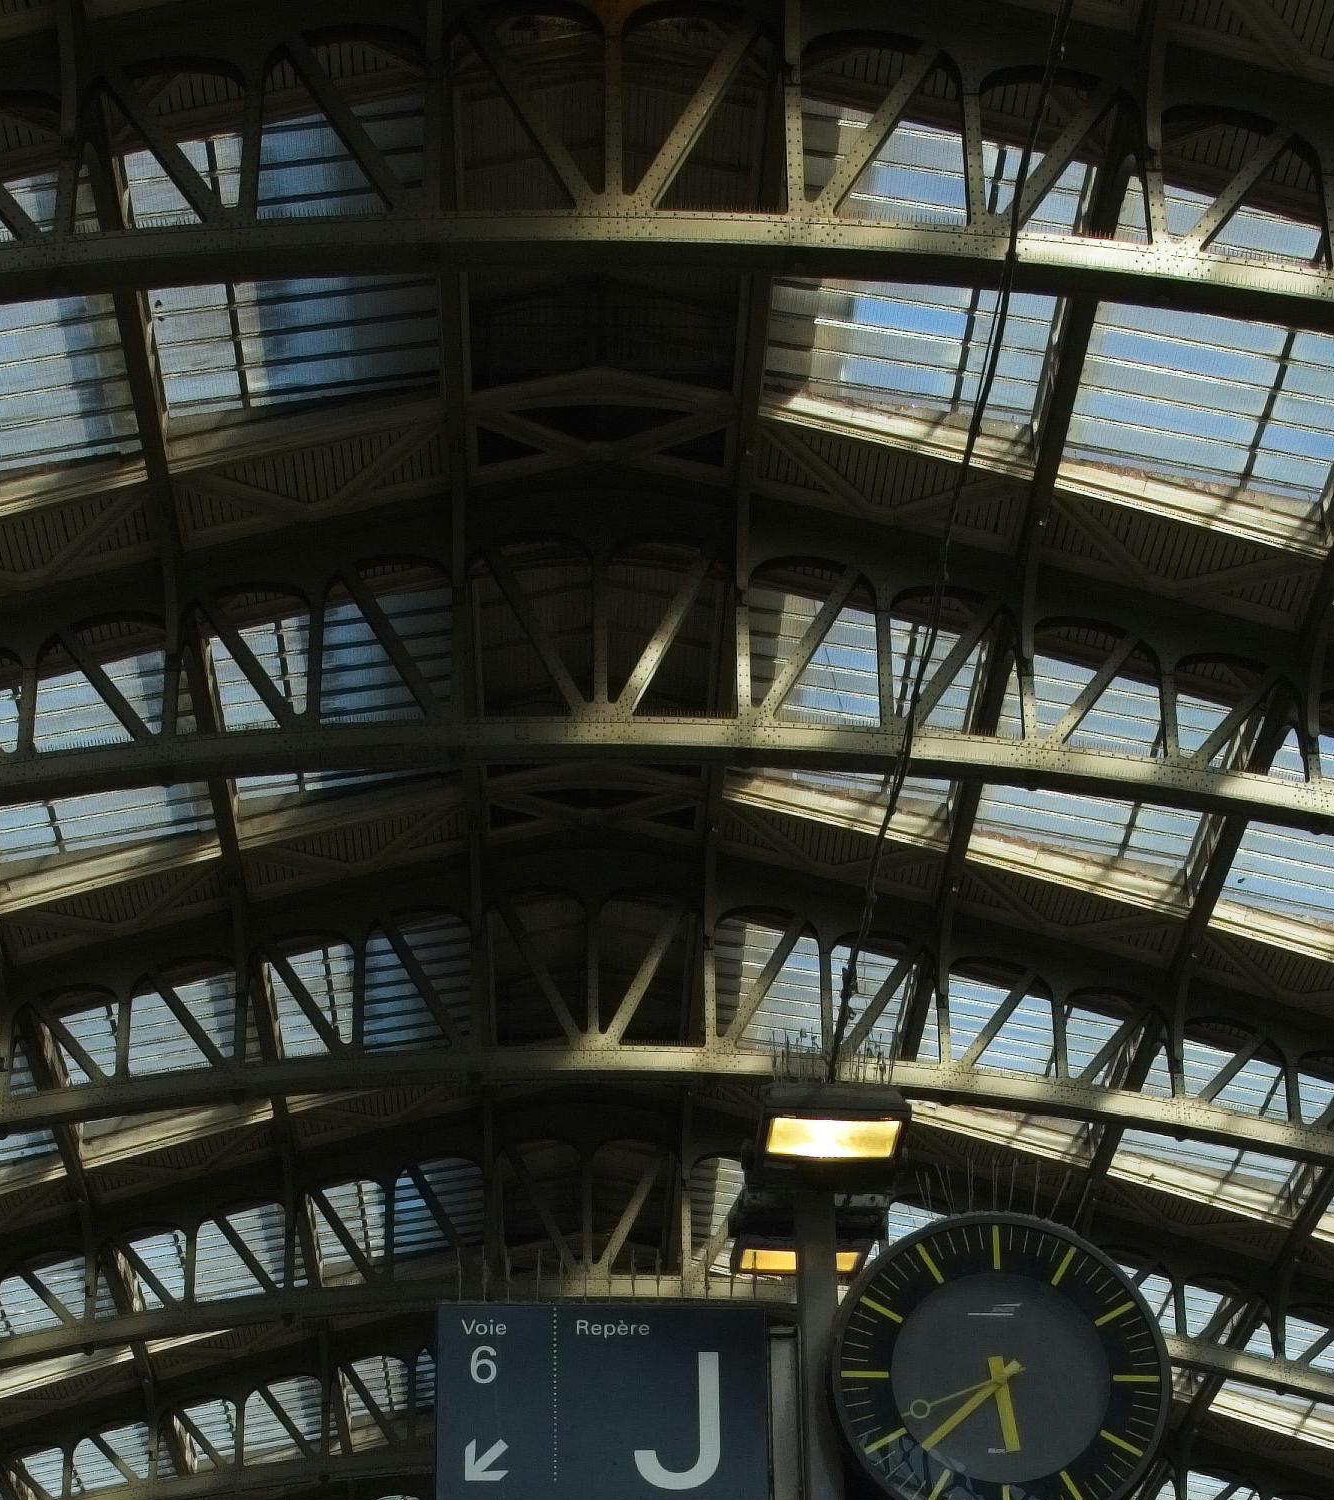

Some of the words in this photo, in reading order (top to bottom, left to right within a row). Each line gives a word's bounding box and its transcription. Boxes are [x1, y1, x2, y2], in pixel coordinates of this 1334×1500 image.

[462, 1318, 507, 1336] Voie
[576, 1318, 650, 1339] Repère
[470, 1345, 497, 1384] 6
[634, 1351, 721, 1490] J
